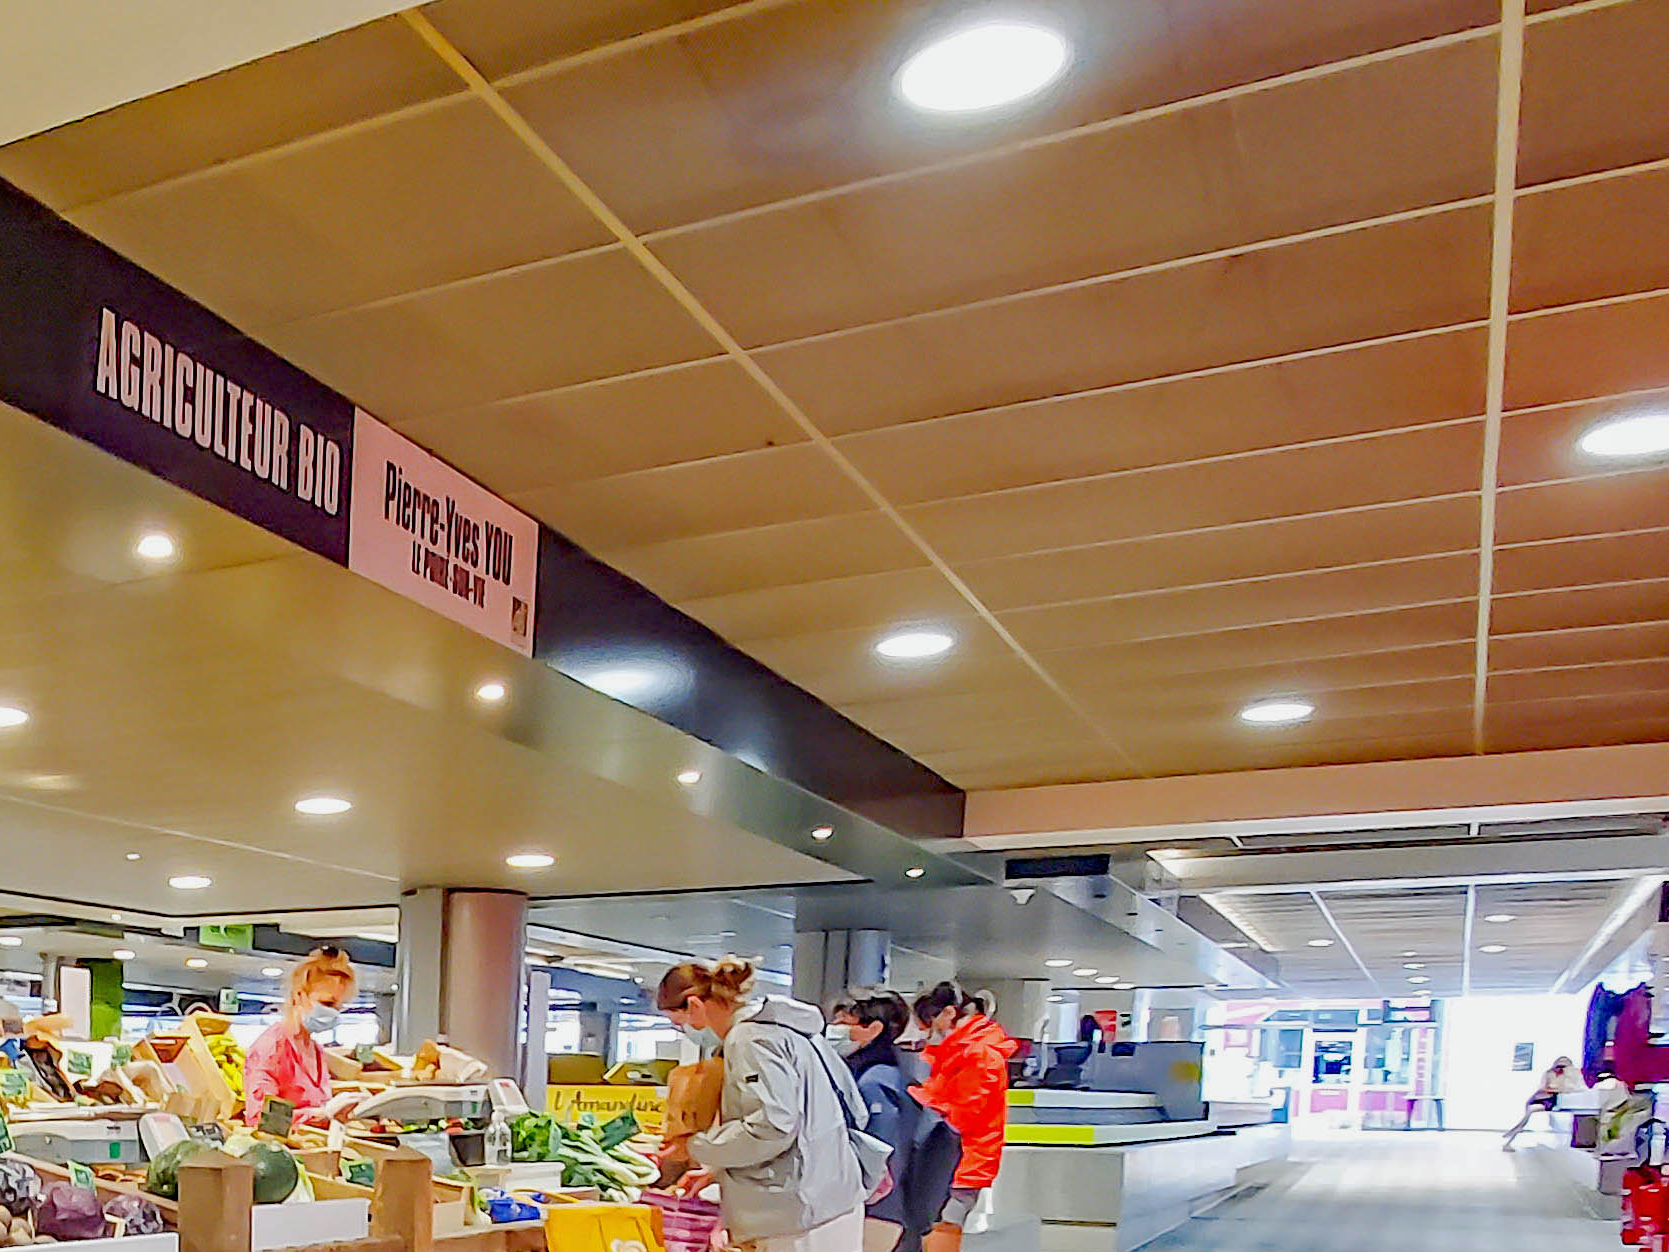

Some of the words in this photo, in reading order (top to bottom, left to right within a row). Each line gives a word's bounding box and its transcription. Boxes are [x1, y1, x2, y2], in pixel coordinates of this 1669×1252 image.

[96, 307, 290, 491] AGRICULTEUR
[297, 423, 341, 517] BIO
[384, 460, 480, 570] Pierre-Yves
[484, 520, 514, 587] YOU
